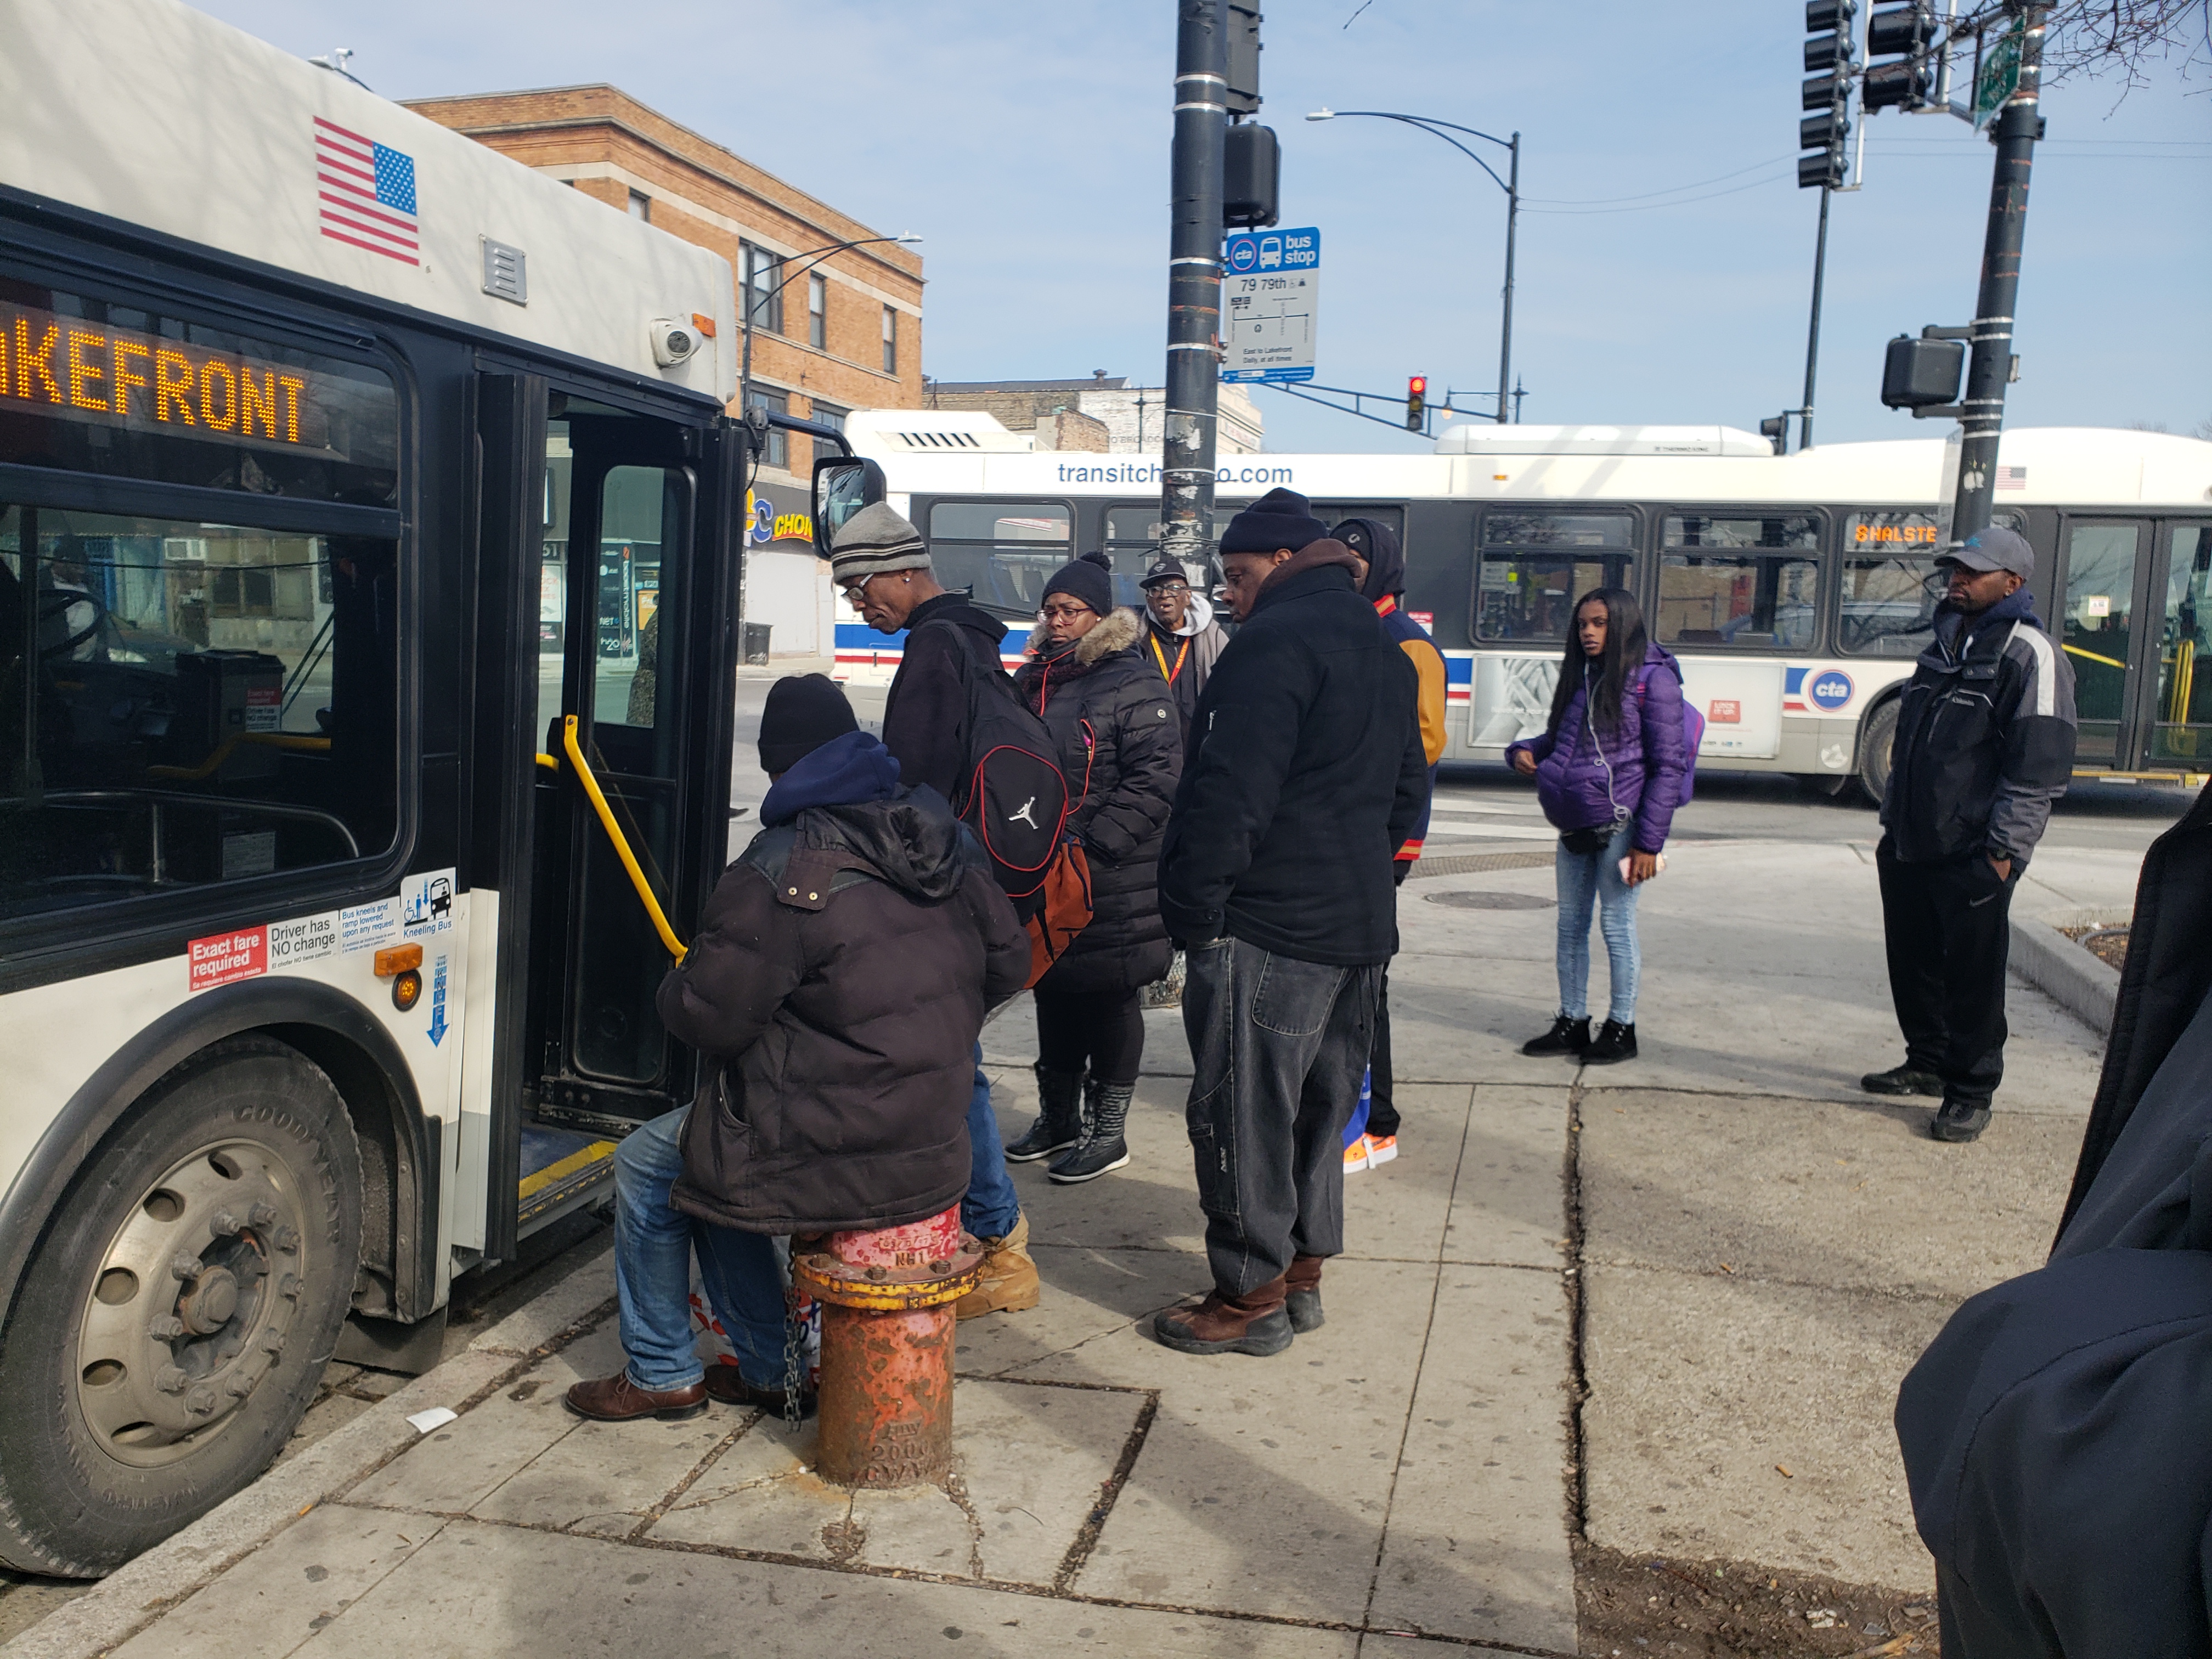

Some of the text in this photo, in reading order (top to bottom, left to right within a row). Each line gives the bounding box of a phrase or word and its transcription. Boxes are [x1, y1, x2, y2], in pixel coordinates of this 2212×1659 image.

[1285, 235, 1312, 249] bus
[1235, 250, 1252, 261] cta
[1284, 250, 1316, 266] stop
[1241, 278, 1286, 291] 79 79th
[0, 317, 304, 442] KEFRONT
[1058, 463, 1293, 483] transitcho.com
[1855, 524, 1938, 543] 8 HALSTE
[1815, 681, 1848, 697] cta
[342, 902, 388, 919] Bus kneels and
[272, 919, 330, 941] Driver has
[342, 912, 383, 929] ramp lowered
[342, 918, 394, 939] upon any request
[403, 920, 452, 939] Kneeling Bus
[193, 934, 260, 961] Exact fare
[272, 940, 291, 958] NO
[294, 933, 335, 952] change
[193, 949, 250, 978] required
